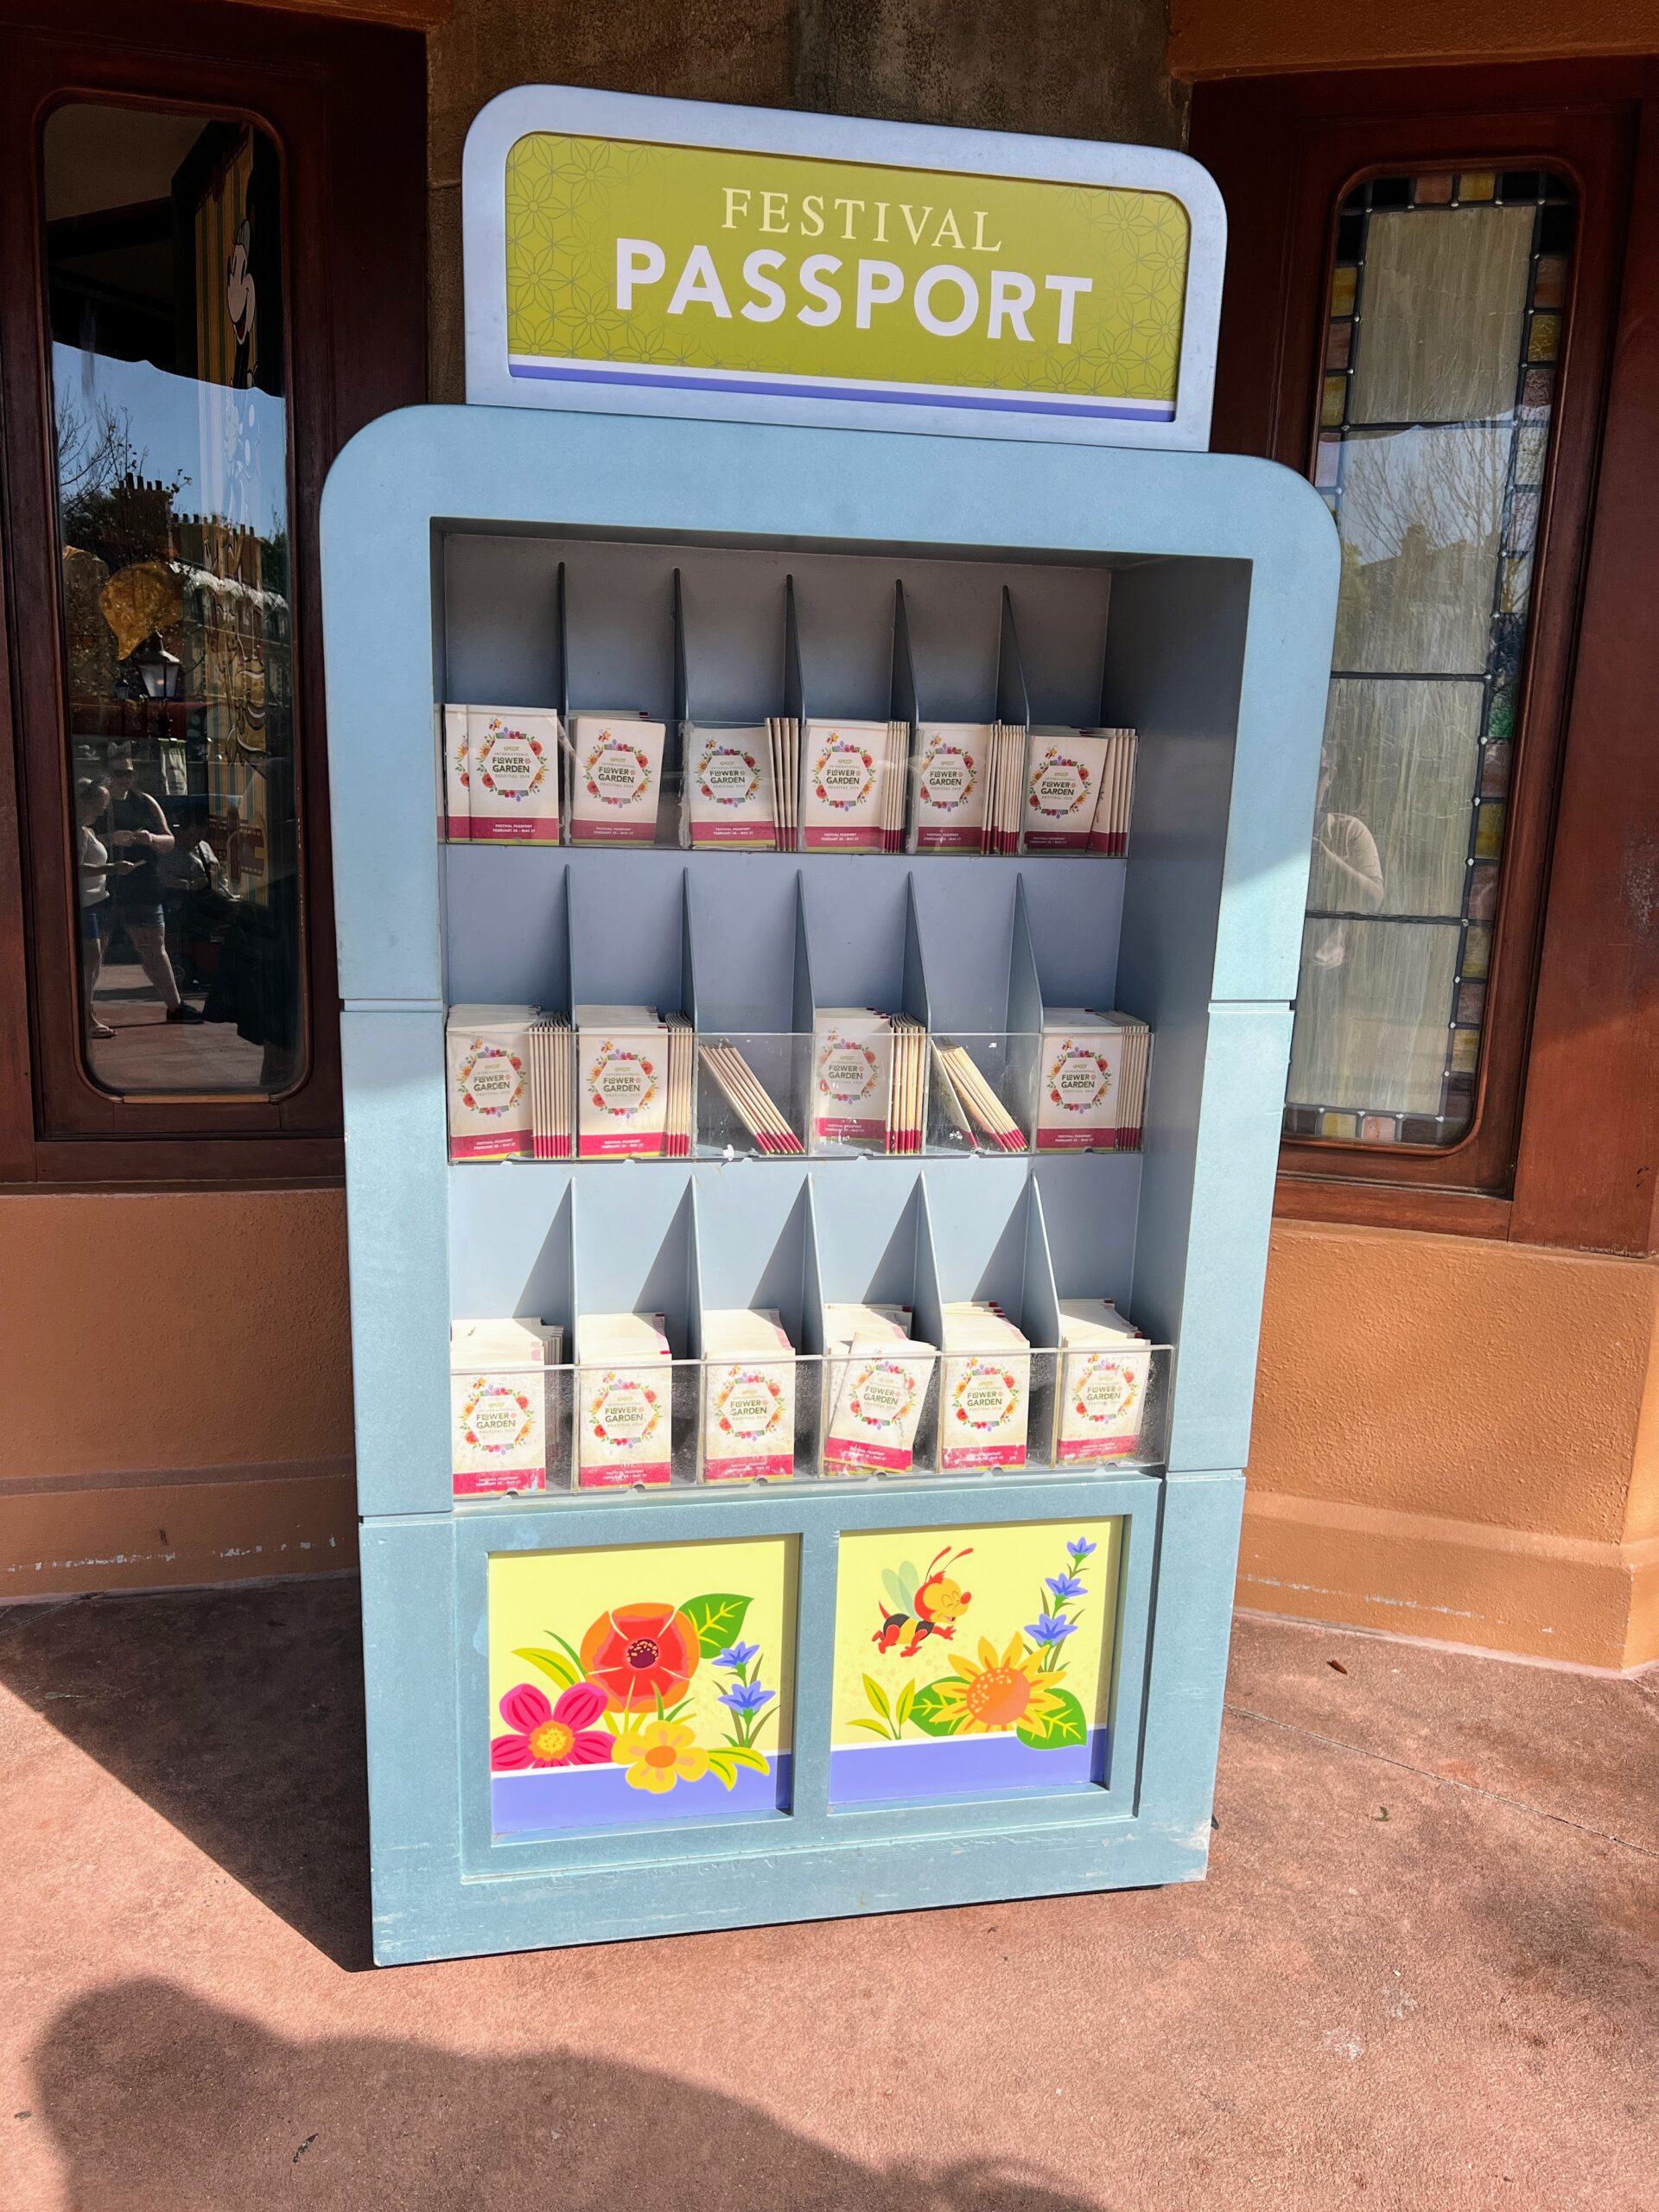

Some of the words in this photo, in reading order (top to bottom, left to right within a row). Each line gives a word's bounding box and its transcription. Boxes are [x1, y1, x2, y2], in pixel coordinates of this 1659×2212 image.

[721, 187, 1002, 252] FESTIVAL
[615, 238, 1094, 345] PASSPORT
[598, 766, 629, 775] FLOWER
[598, 773, 634, 783] GARDEN
[474, 1074, 504, 1084] FLOWER
[474, 1081, 511, 1091] GARDEN
[865, 1385, 895, 1396] FLOWER
[730, 1400, 761, 1408] FLOWER
[864, 1393, 899, 1405] GARDEN
[731, 1407, 767, 1416] GARDEN
[605, 1414, 643, 1422] GARDEN
[476, 1420, 516, 1428] GARDEN
